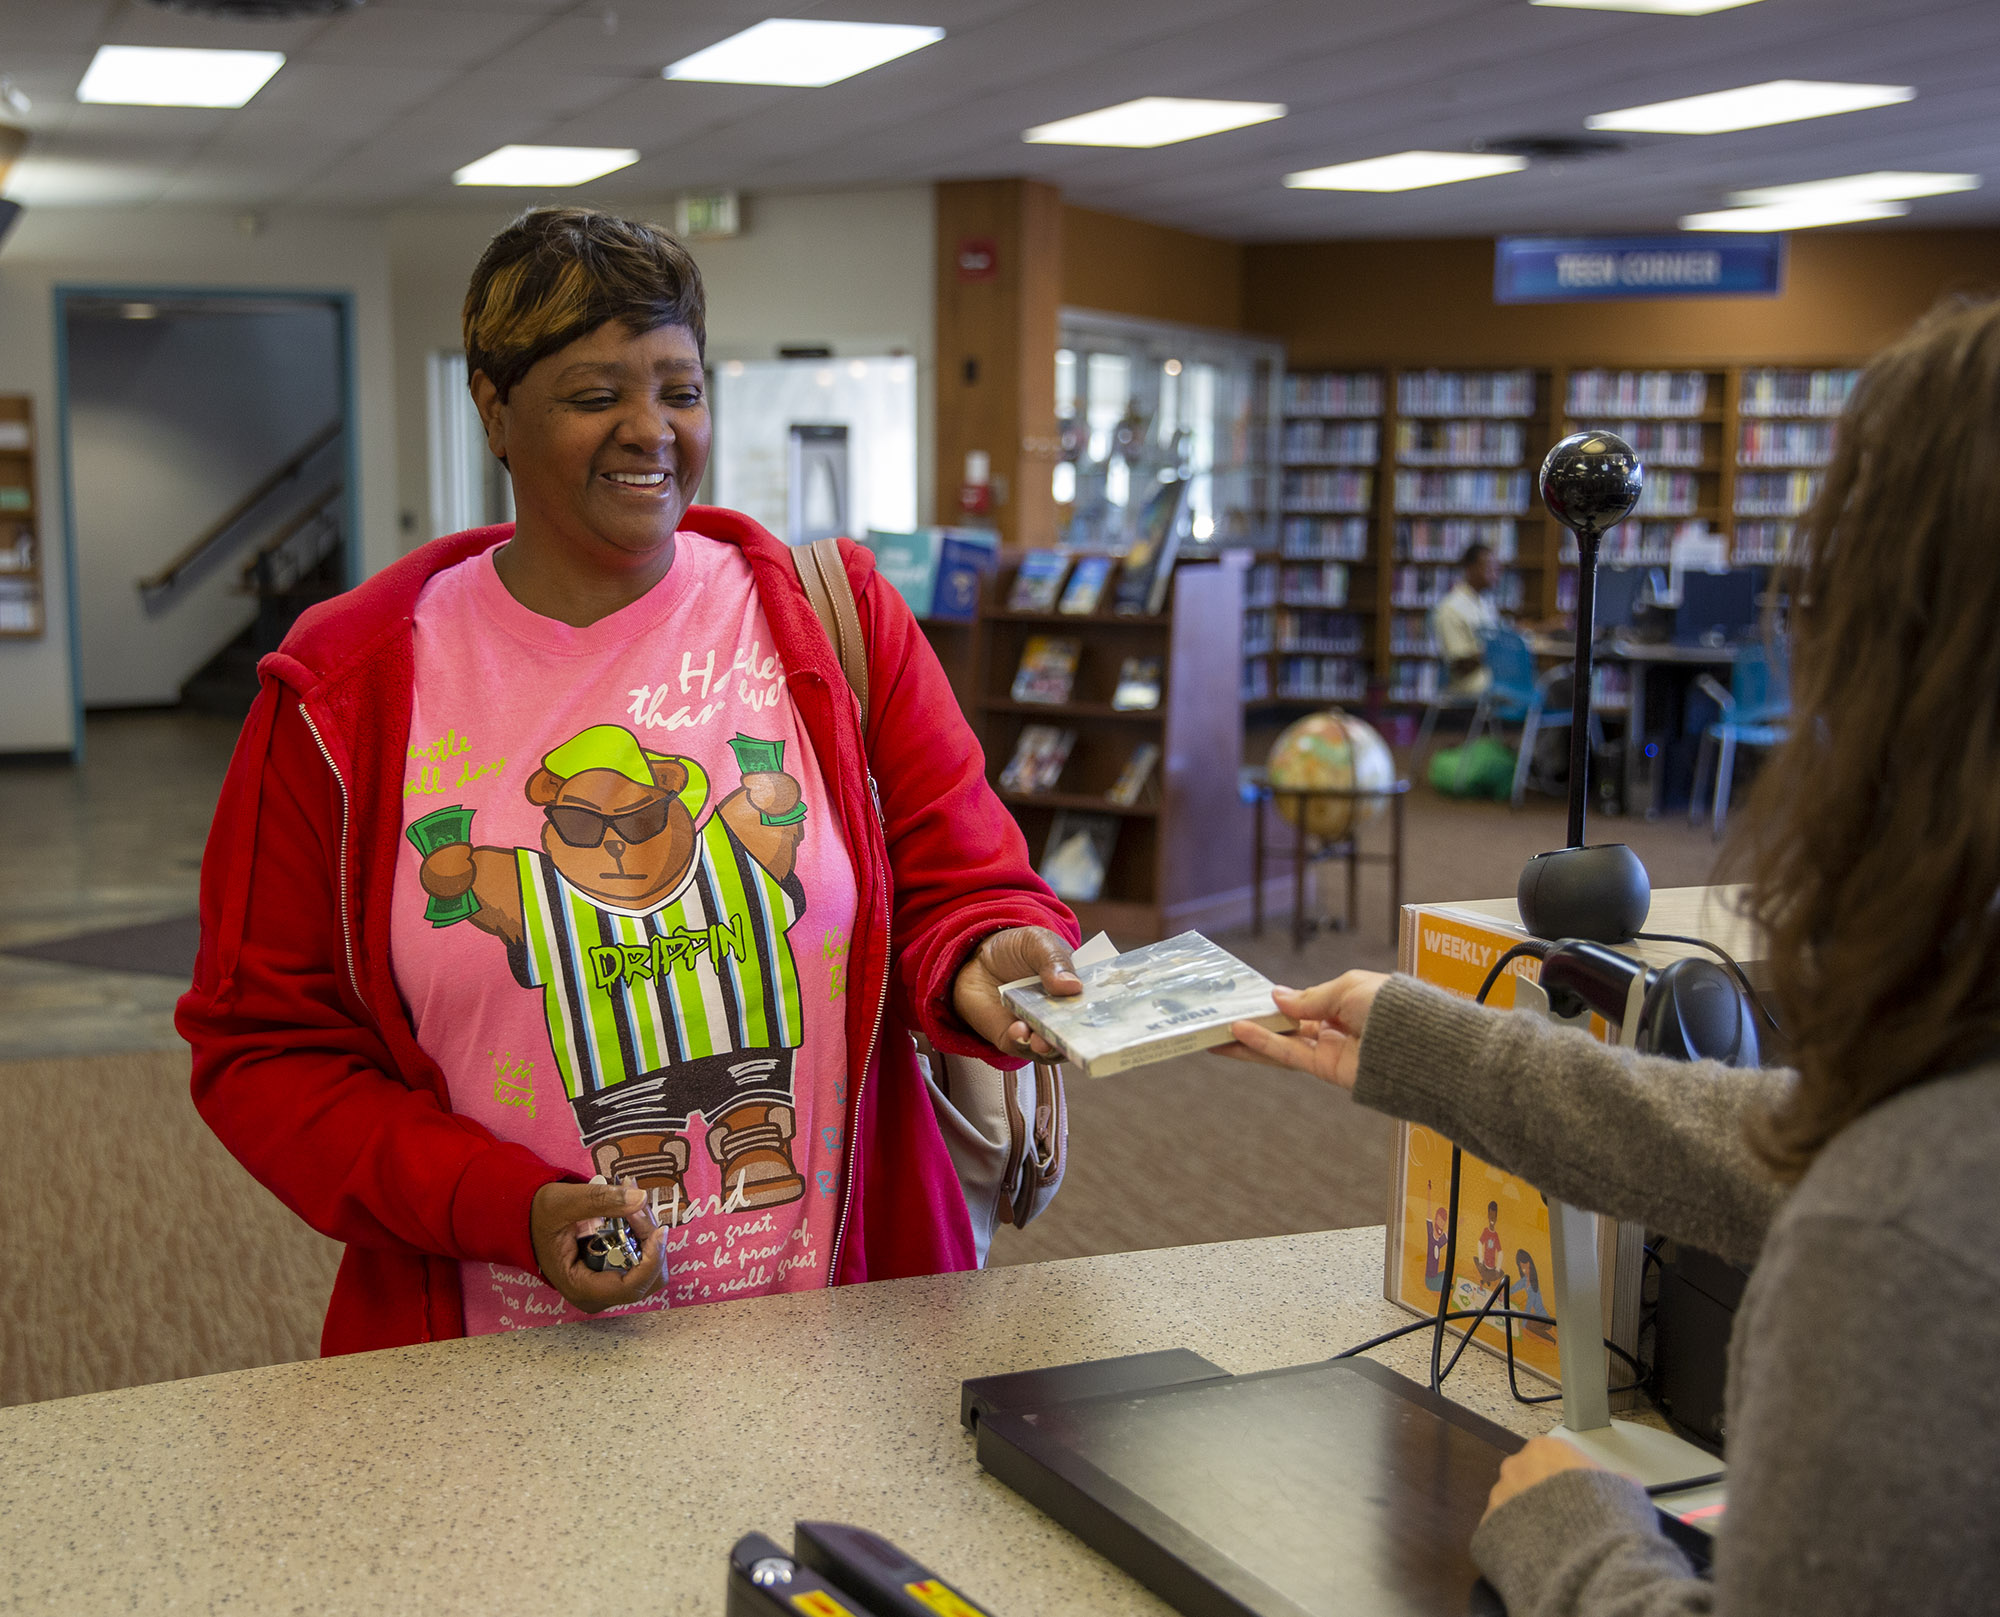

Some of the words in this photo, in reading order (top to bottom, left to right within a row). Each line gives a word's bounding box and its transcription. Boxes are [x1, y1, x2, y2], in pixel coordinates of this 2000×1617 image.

[408, 728, 472, 763] ustle
[403, 765, 446, 799] all
[588, 912, 746, 998] DRIPPIN
[1423, 928, 1491, 968] WEEKLY
[494, 1080, 537, 1119] King
[651, 1168, 752, 1229] Hard
[696, 1230, 718, 1245] or
[670, 1258, 708, 1276] can
[714, 1245, 732, 1270] be
[524, 1292, 567, 1316] hard
